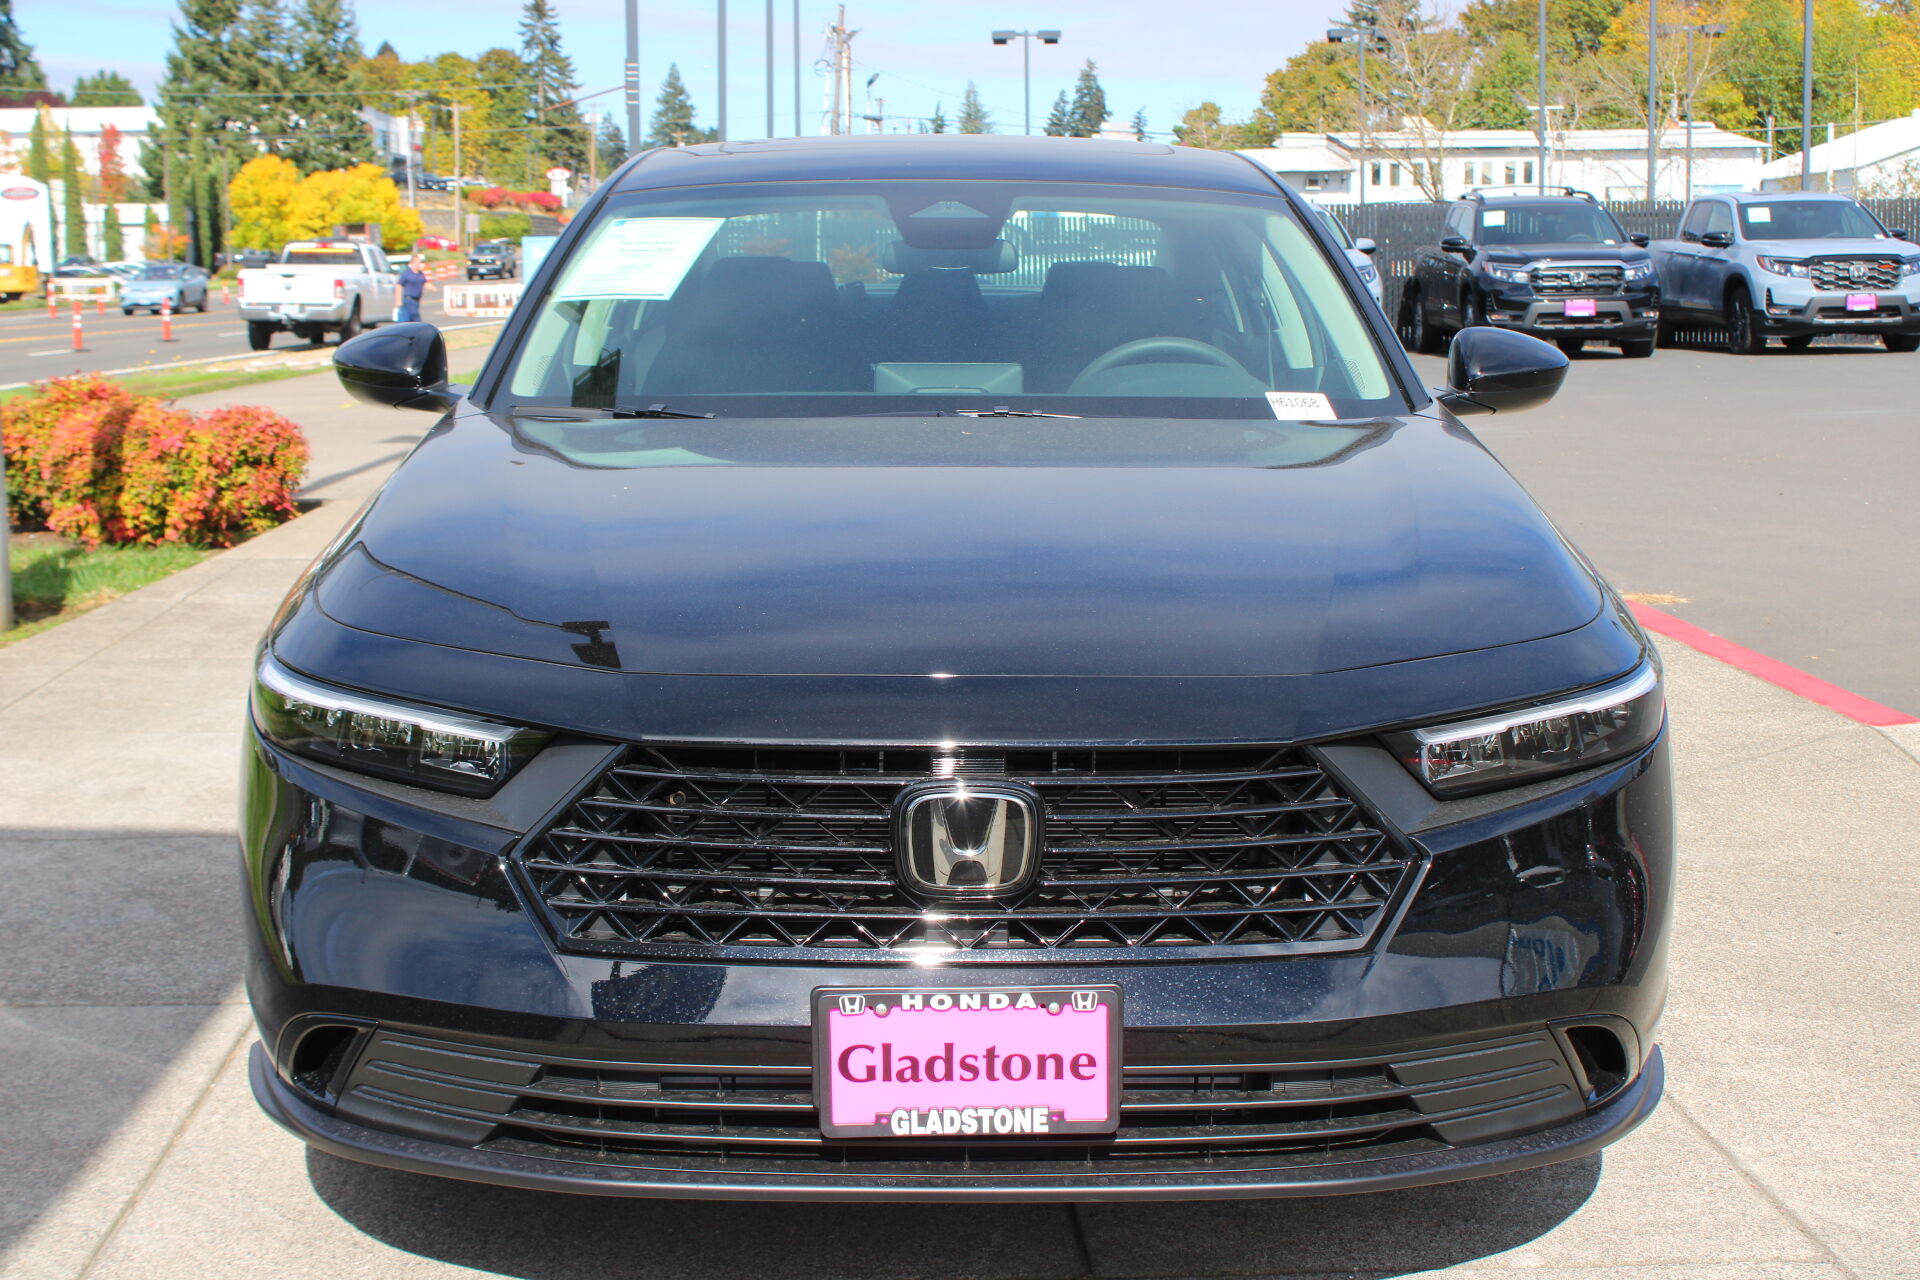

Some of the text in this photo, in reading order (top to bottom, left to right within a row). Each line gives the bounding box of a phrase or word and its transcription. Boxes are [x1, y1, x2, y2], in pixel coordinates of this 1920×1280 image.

[901, 992, 1037, 1011] HONDA
[837, 1042, 1097, 1083] Gladstone
[890, 1106, 1049, 1136] GLADSTONE
